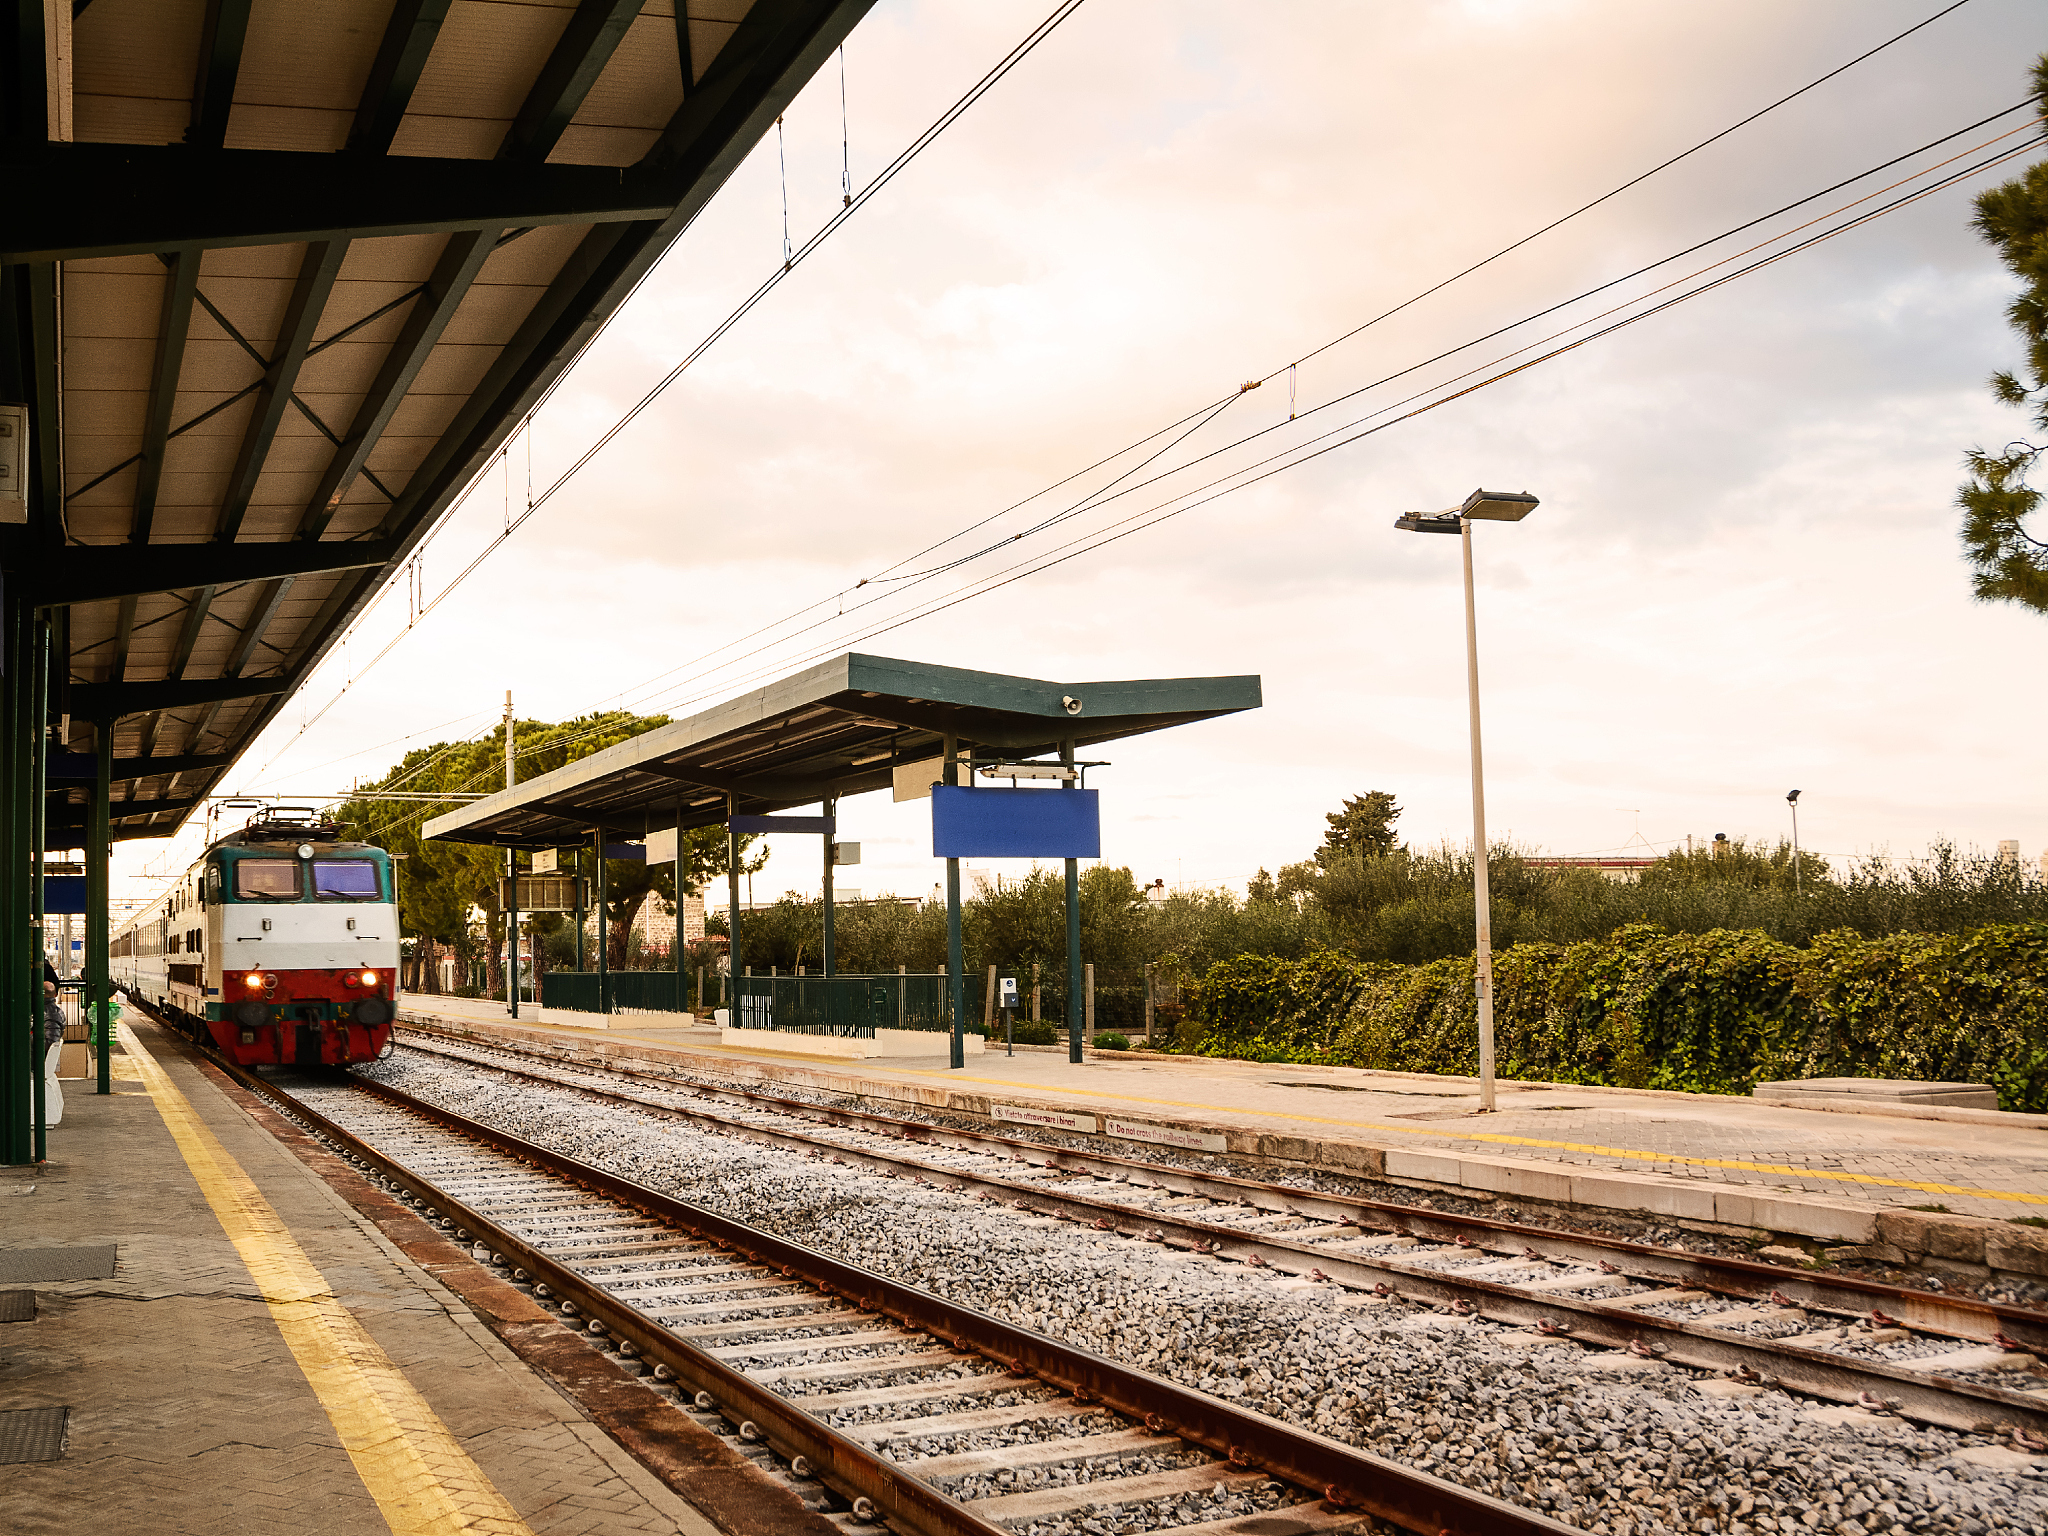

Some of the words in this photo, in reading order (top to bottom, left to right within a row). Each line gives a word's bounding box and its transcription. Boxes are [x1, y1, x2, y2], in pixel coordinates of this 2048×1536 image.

[1023, 1112, 1056, 1124] attraversare
[1059, 1115, 1076, 1127] binari
[1116, 1124, 1125, 1134] Do
[1125, 1127, 1136, 1136] not
[1136, 1130, 1152, 1138] cross
[1152, 1129, 1162, 1140] the
[1163, 1132, 1186, 1146] railway
[1186, 1134, 1203, 1146] lines
